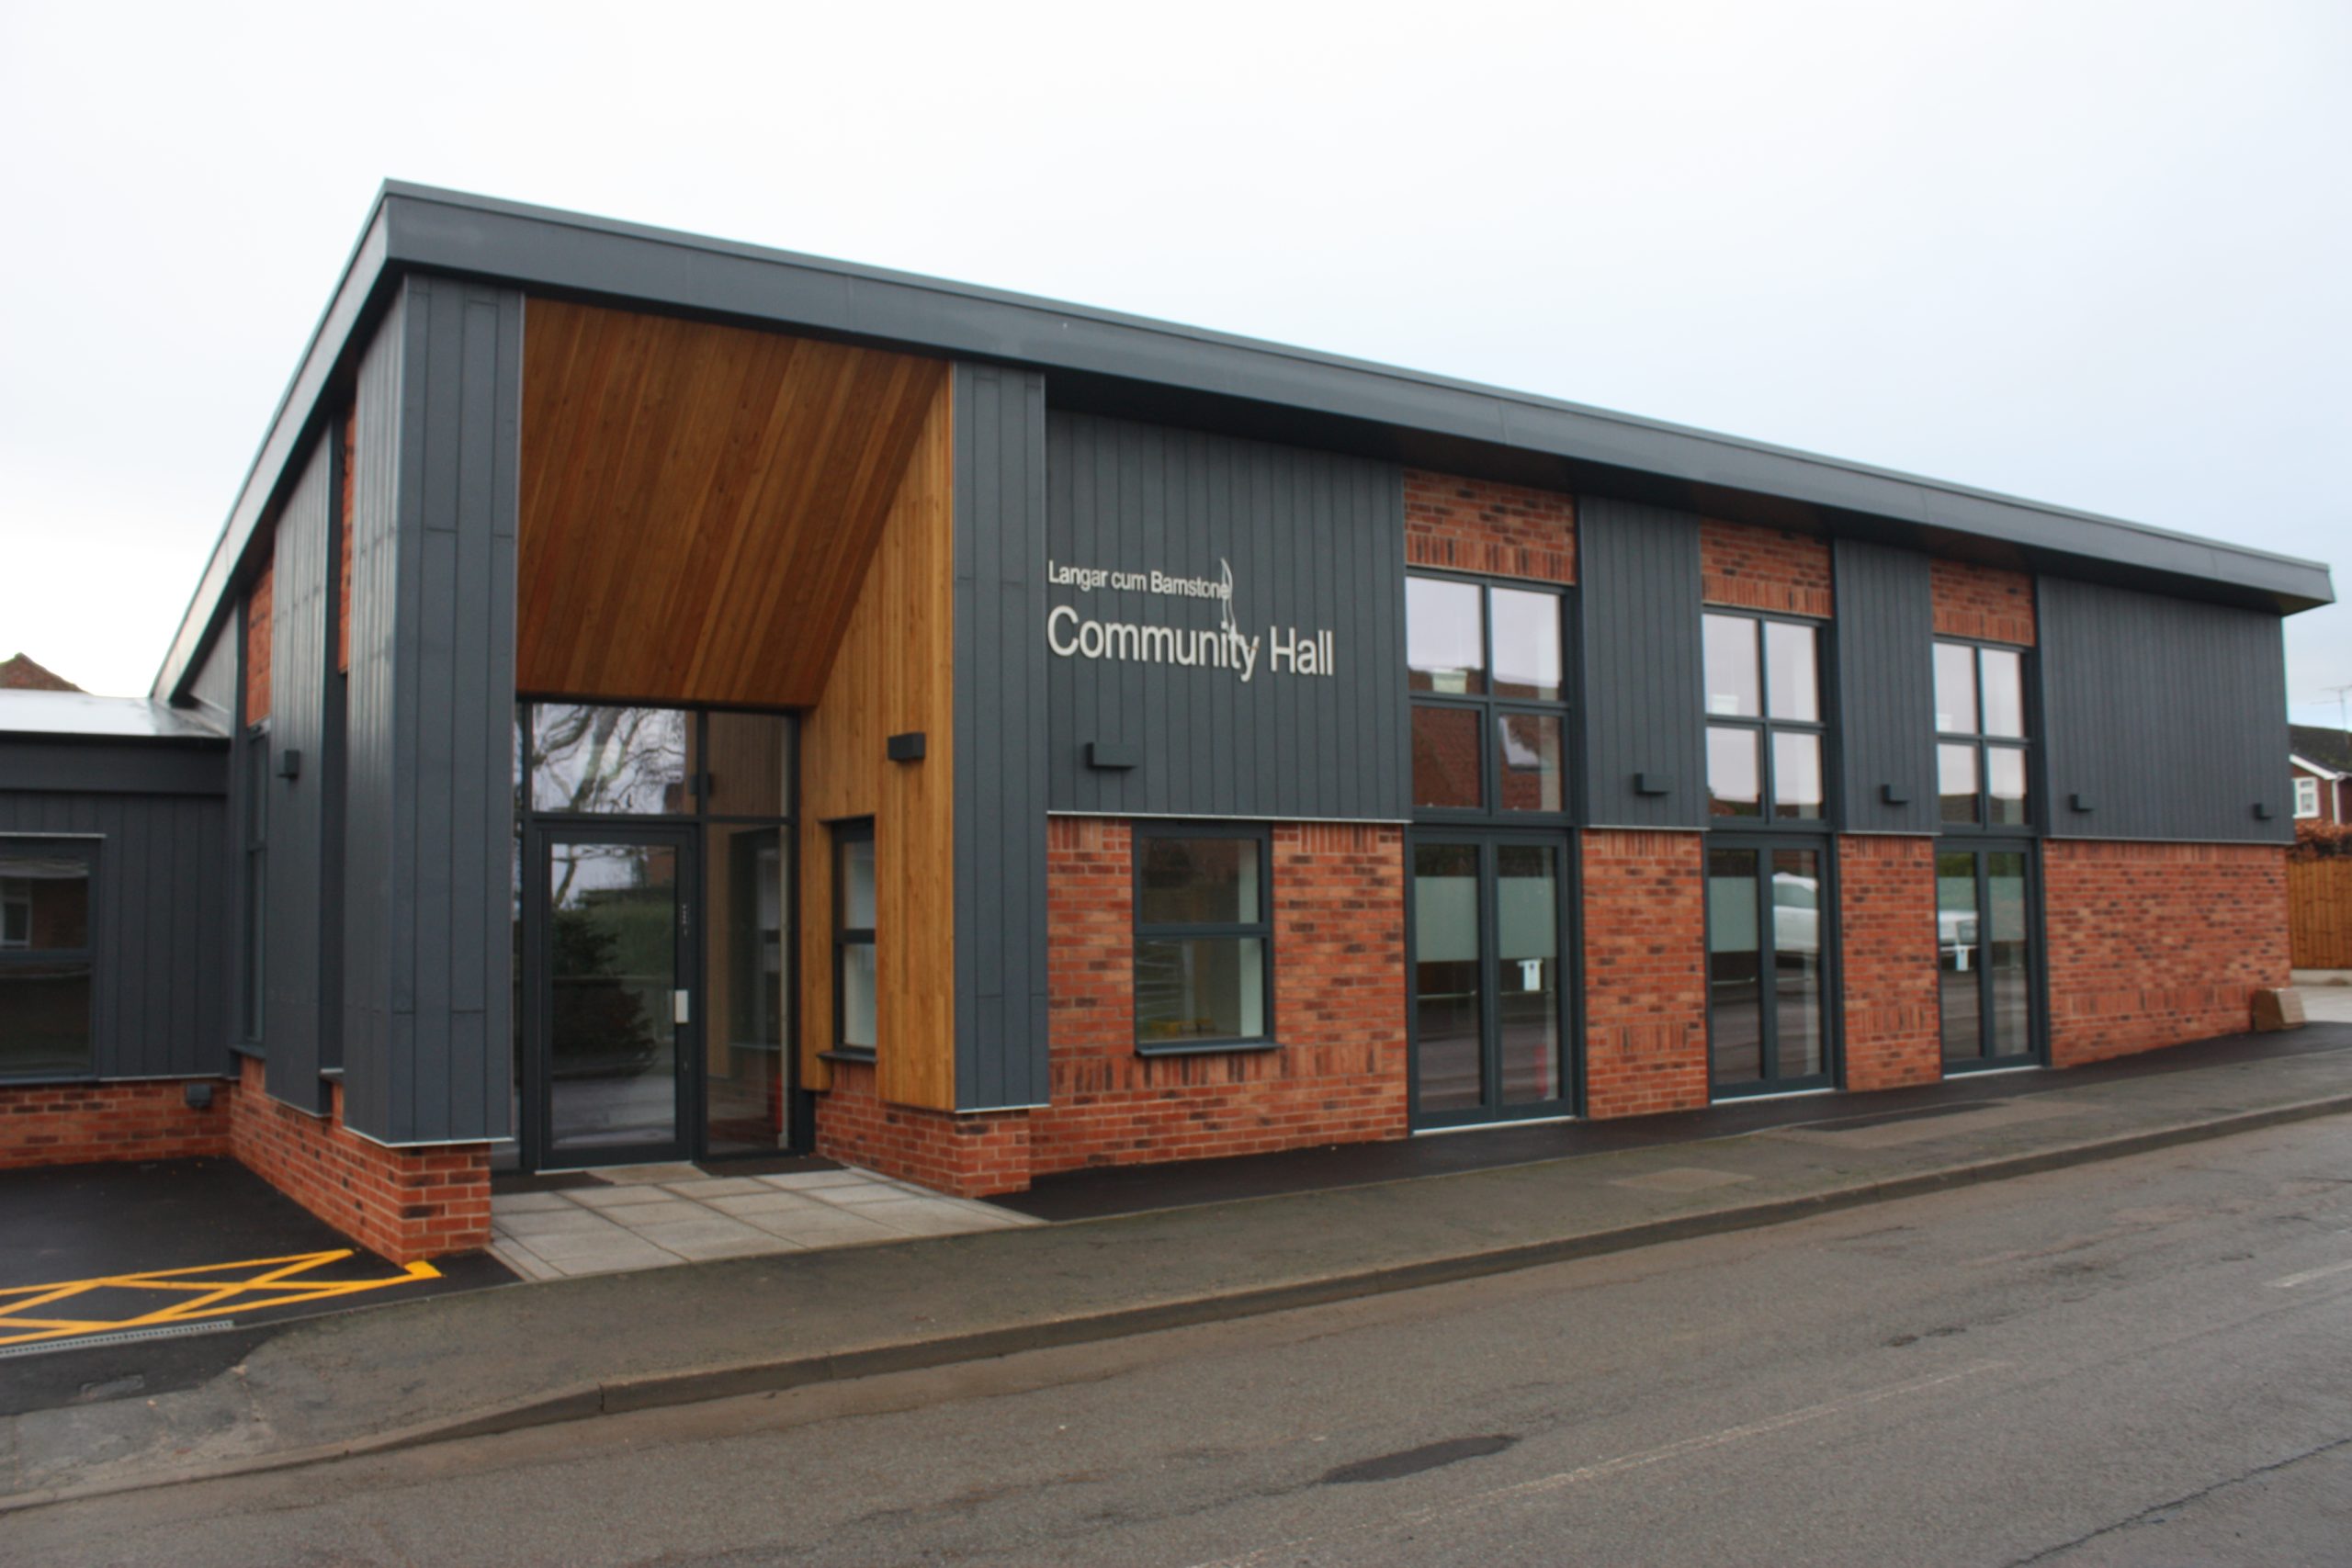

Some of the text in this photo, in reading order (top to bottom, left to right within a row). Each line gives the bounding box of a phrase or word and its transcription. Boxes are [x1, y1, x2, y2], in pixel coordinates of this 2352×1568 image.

[1048, 559, 1107, 592] Langar
[1111, 570, 1148, 592] cum
[1047, 604, 1333, 682] Community Hall
